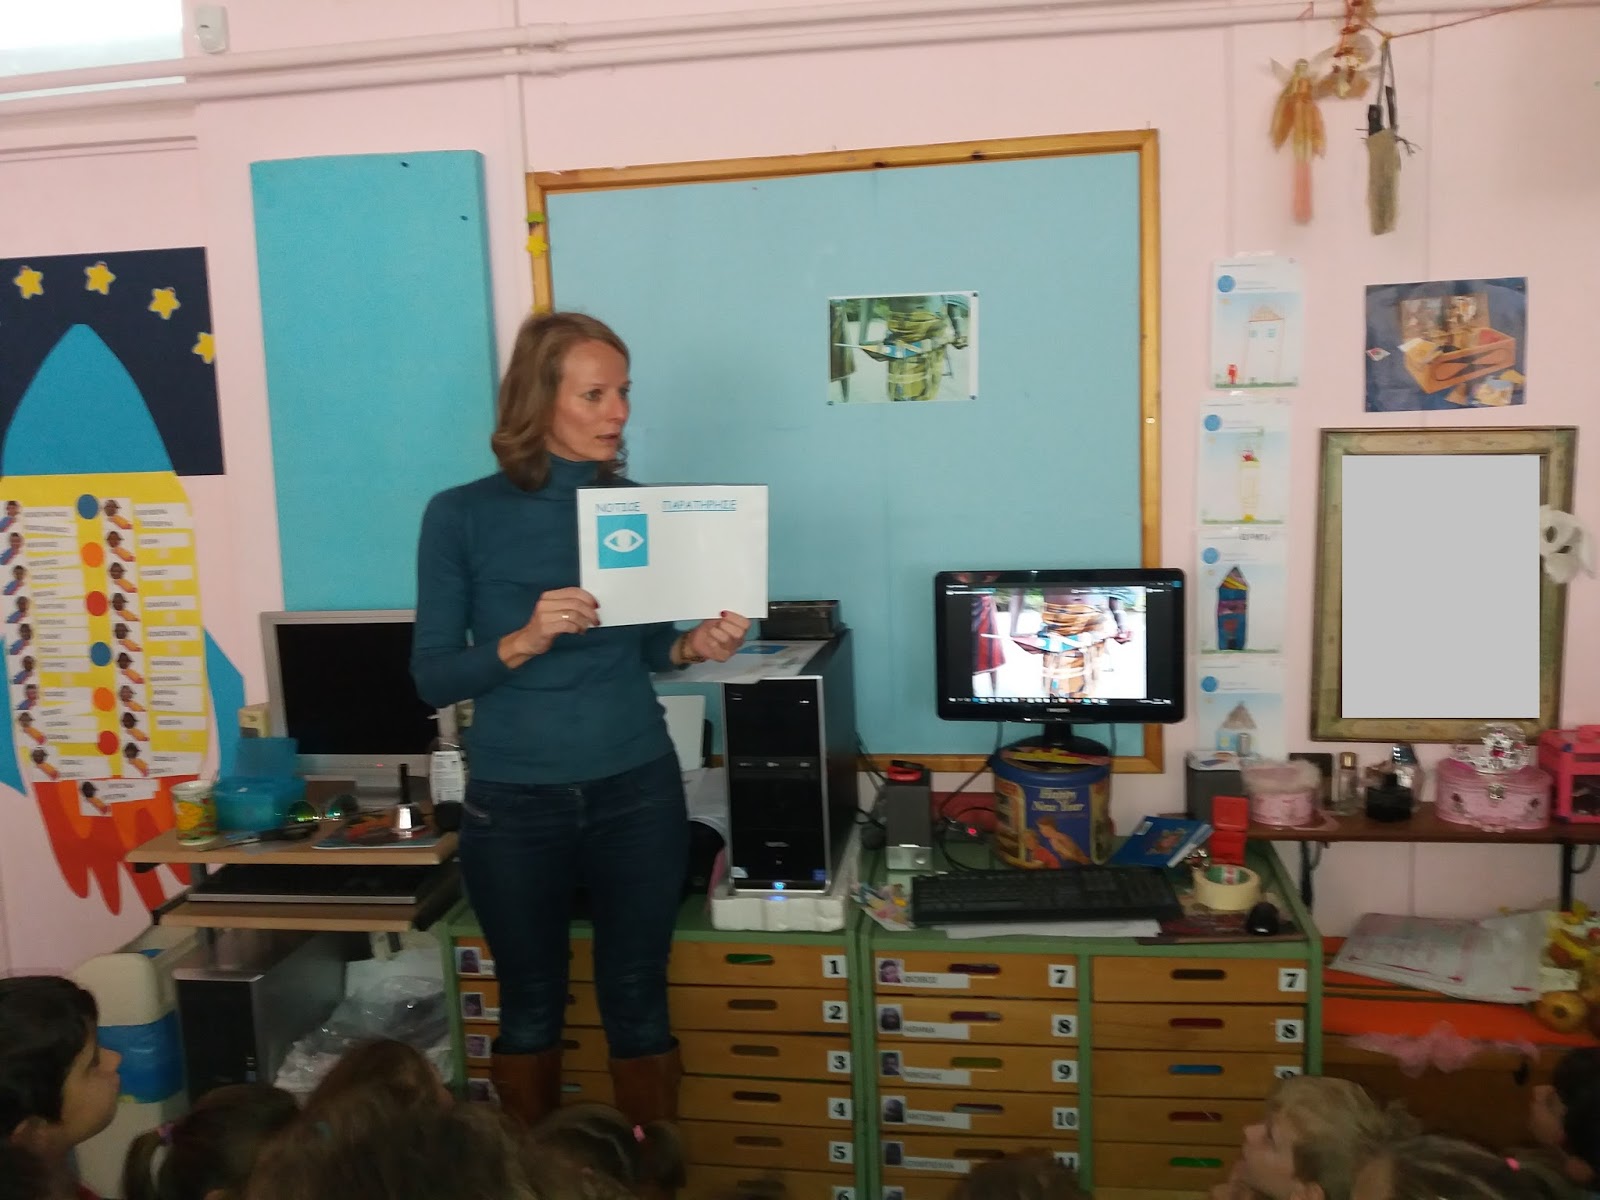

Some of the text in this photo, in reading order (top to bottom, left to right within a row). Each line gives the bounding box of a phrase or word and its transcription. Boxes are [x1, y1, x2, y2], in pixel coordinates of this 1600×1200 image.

[595, 502, 640, 513] NOTICE
[829, 959, 841, 975] 1
[1053, 968, 1068, 984] 7
[1284, 972, 1299, 988] 7
[828, 1005, 842, 1020] 2
[1056, 1019, 1072, 1034] 8
[1282, 1023, 1298, 1039] 8
[834, 1055, 846, 1070] 3
[1056, 1064, 1072, 1080] 9
[833, 1102, 846, 1117] 4
[1056, 1111, 1077, 1127] 10
[833, 1145, 846, 1160] 5
